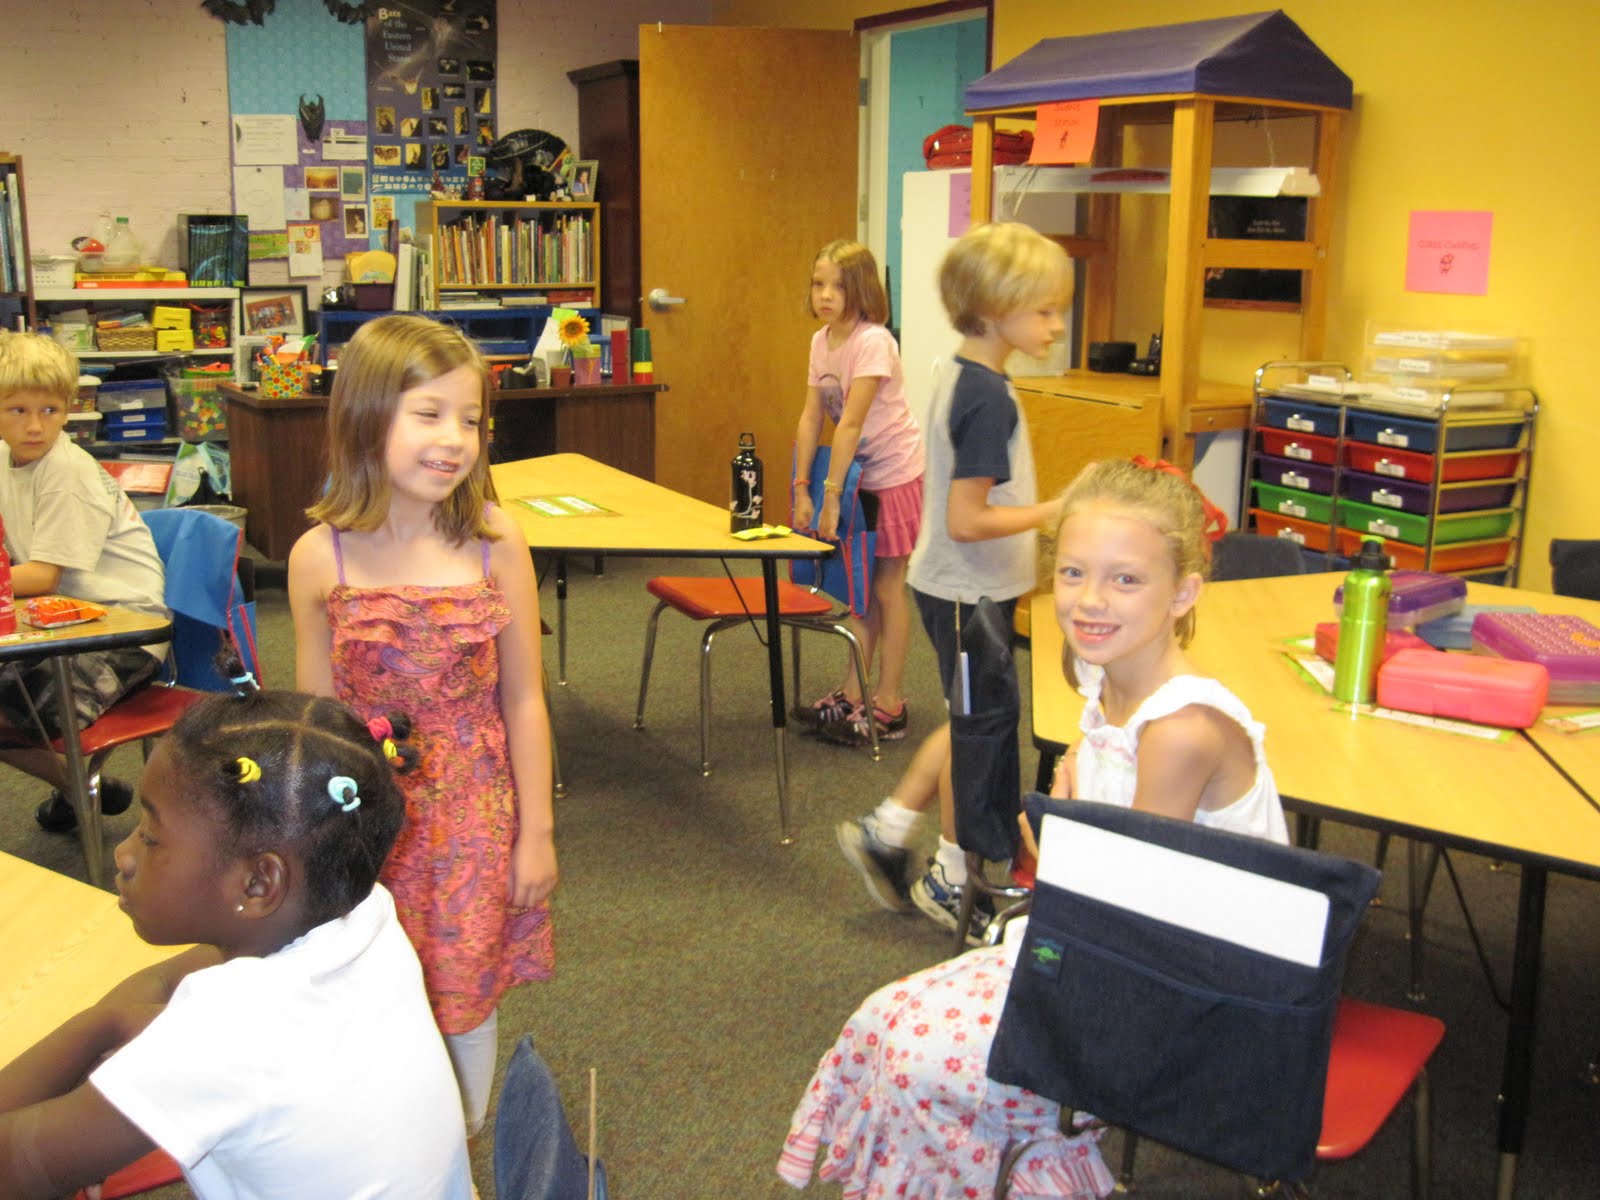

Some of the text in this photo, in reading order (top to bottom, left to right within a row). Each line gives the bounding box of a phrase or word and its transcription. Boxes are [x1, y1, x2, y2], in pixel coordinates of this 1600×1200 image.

[379, 7, 401, 20] Bats
[384, 19, 408, 28] of the
[383, 30, 411, 40] Eastern
[385, 42, 411, 51] United
